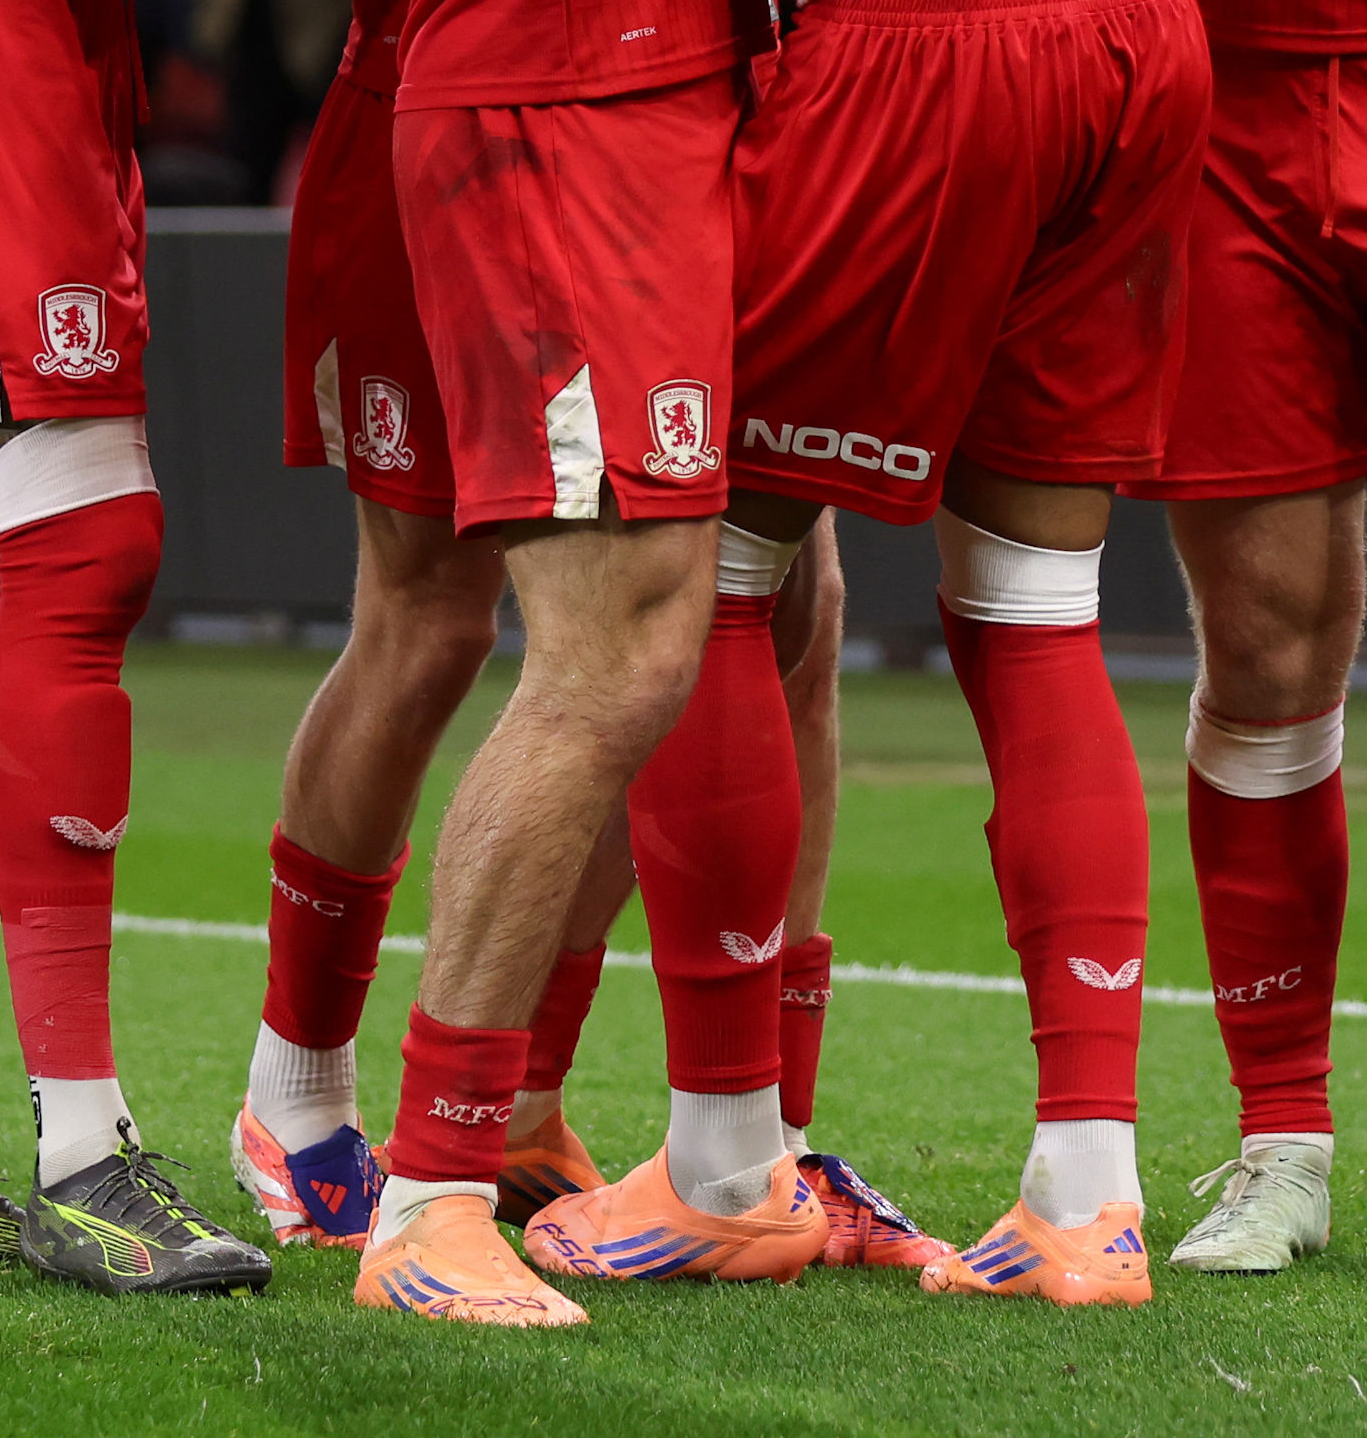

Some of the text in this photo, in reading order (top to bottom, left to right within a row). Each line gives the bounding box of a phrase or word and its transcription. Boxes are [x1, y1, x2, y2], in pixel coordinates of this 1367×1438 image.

[620, 25, 658, 42] AERTEK
[743, 418, 931, 481] NOCO
[270, 867, 344, 917] MFC
[1216, 965, 1302, 1003] MFC
[427, 1096, 514, 1125] MFC
